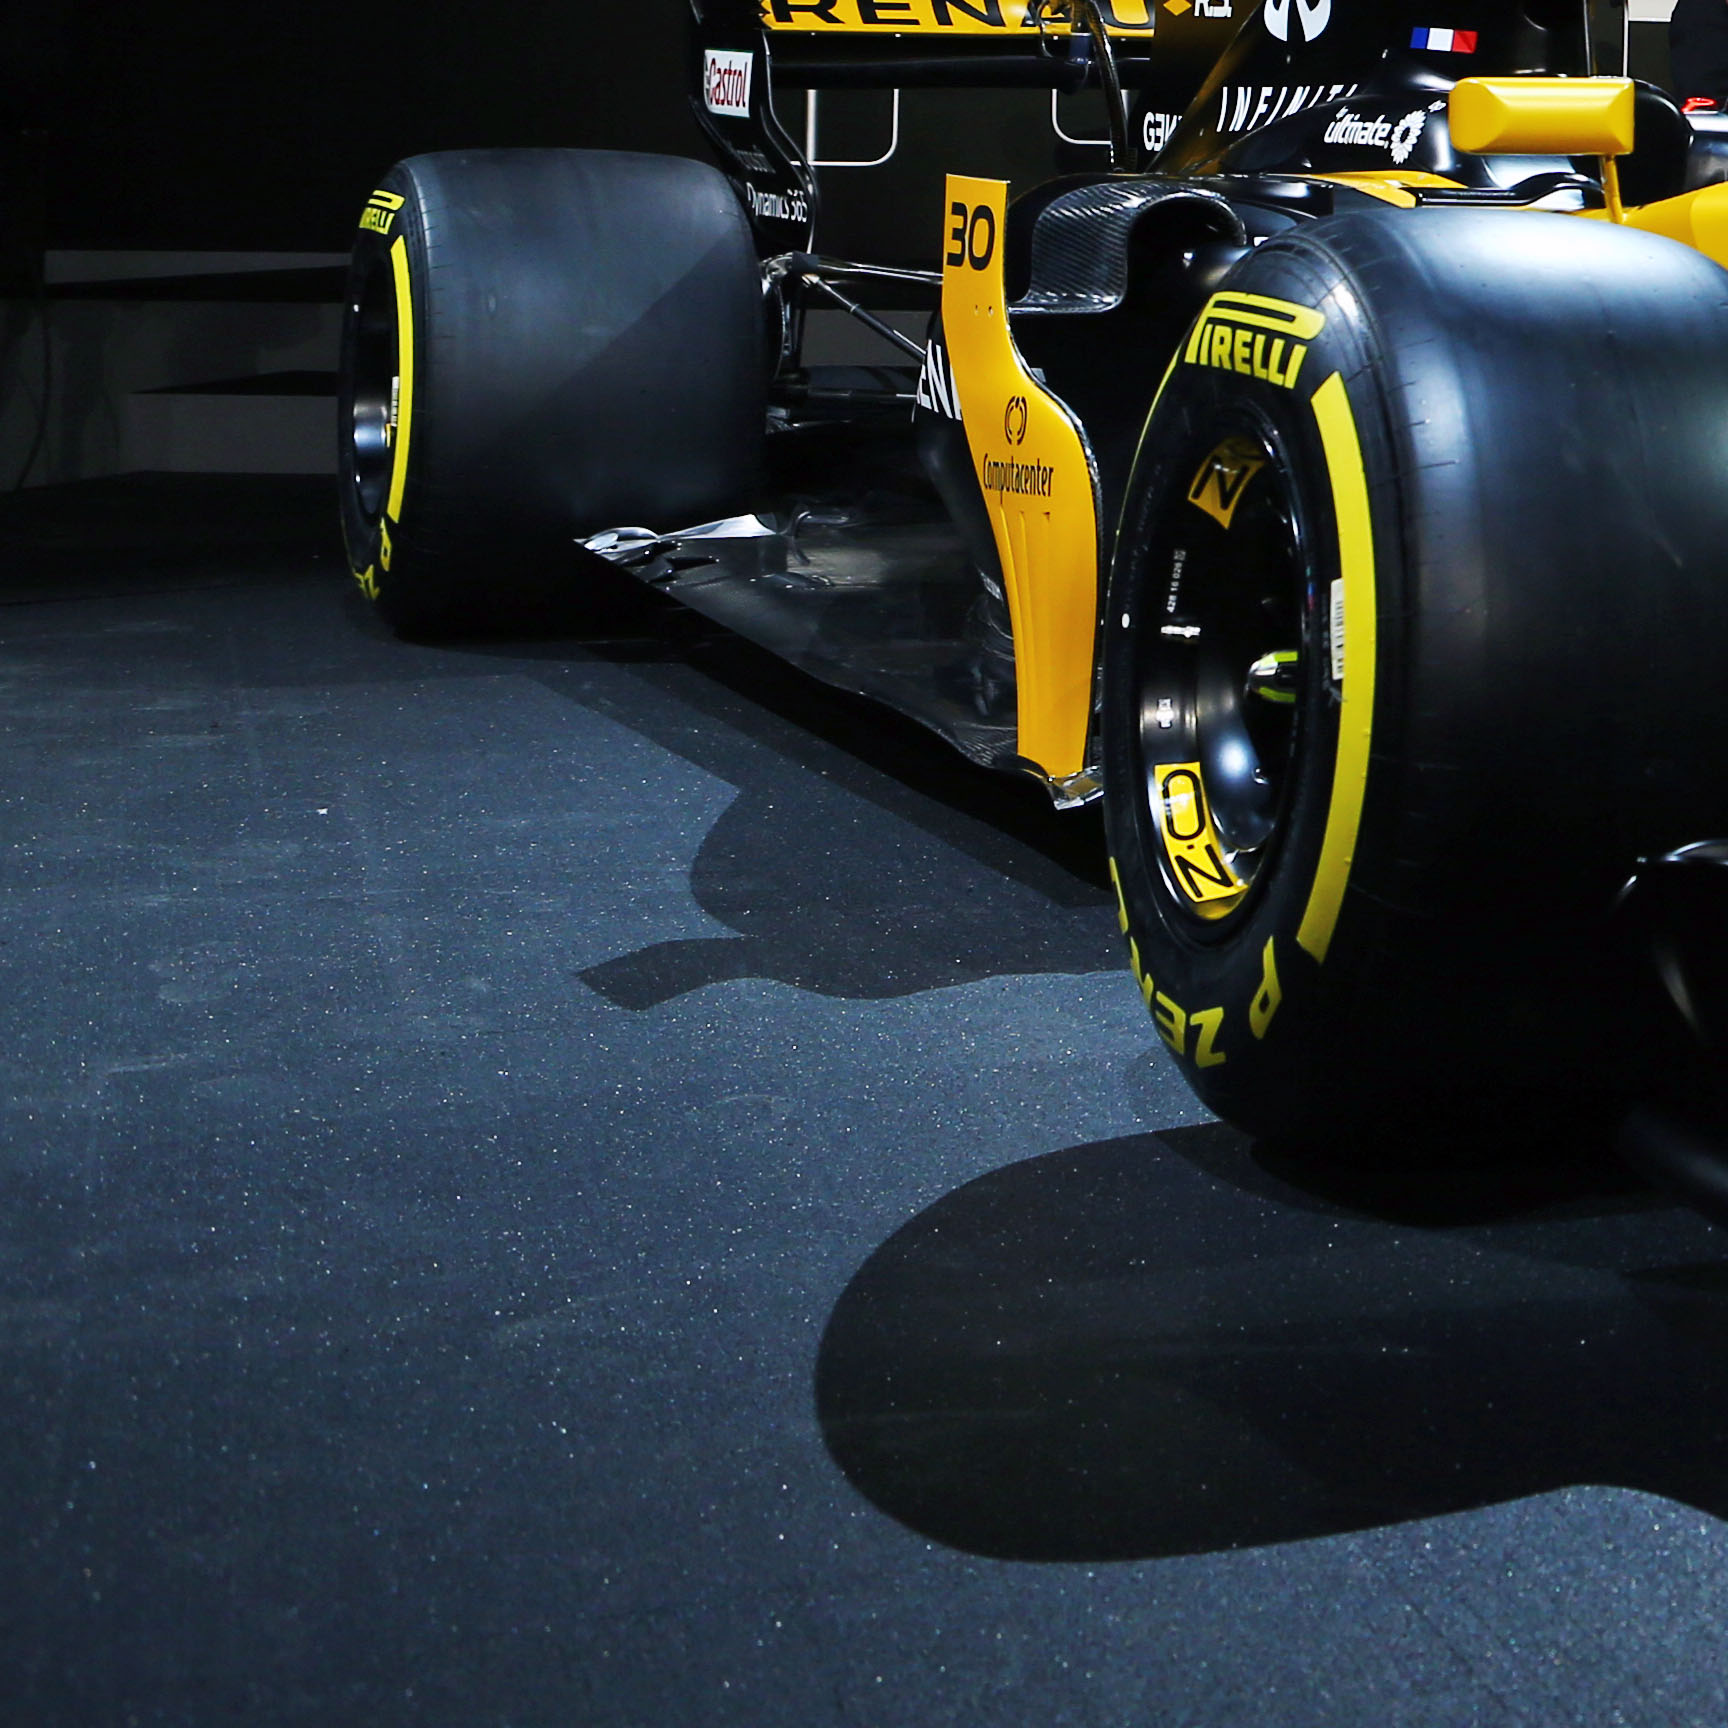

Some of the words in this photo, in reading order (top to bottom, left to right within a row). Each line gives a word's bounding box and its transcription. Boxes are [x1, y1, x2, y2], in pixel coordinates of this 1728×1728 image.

[709, 58, 748, 108] Castrol
[946, 201, 995, 271] 30
[1184, 290, 1327, 390] PIRELLI
[982, 451, 1055, 505] Computacenter
